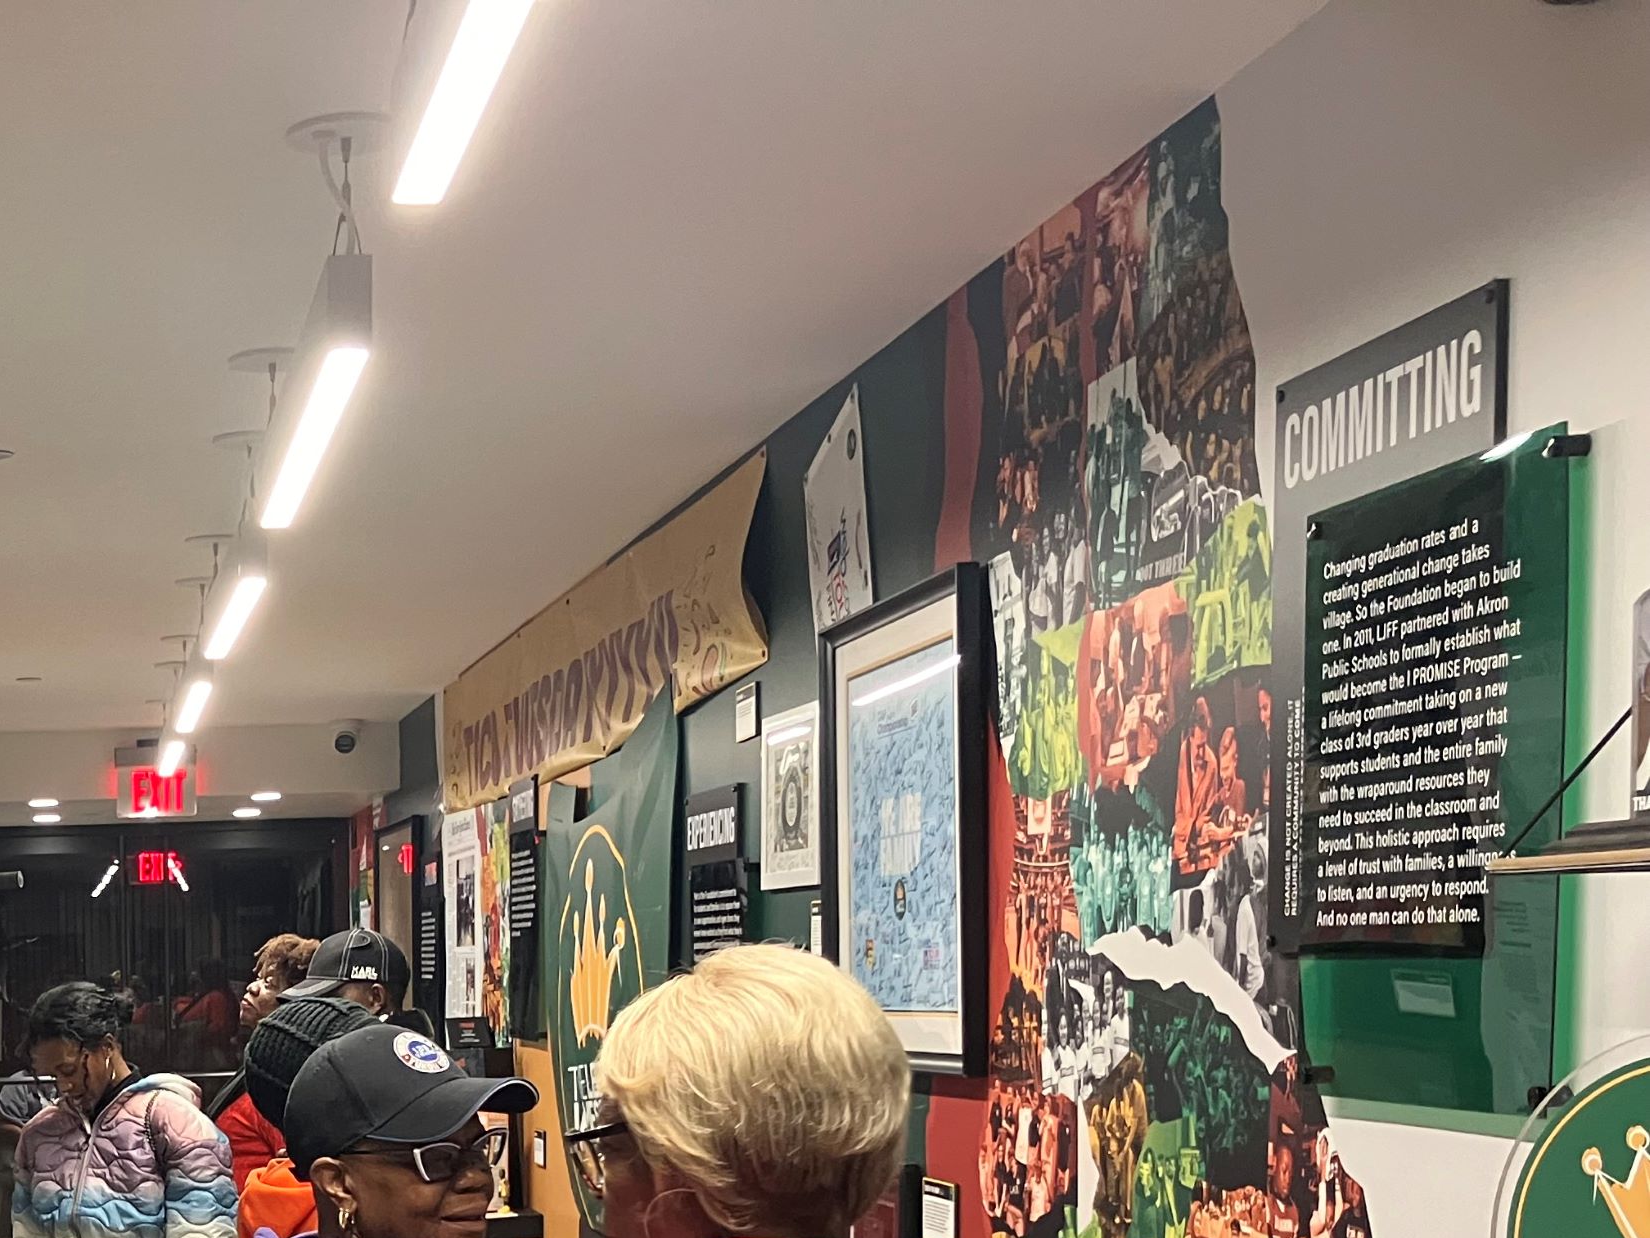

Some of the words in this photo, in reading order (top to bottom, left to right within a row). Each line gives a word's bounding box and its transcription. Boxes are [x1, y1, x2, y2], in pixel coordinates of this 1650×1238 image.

[1283, 328, 1484, 490] COMMITTING
[1323, 554, 1367, 580] Changing
[1367, 537, 1419, 571] graduation
[1421, 529, 1446, 550] rates
[1449, 517, 1468, 541] and
[1471, 519, 1479, 534] a
[1323, 582, 1360, 605] creating
[1361, 560, 1420, 599] generational
[1421, 553, 1459, 576] change
[1461, 543, 1490, 565] takes
[1322, 610, 1354, 630] village.
[1355, 603, 1368, 621] So
[1369, 599, 1386, 617] the
[1387, 584, 1442, 613] Foundation
[1444, 575, 1477, 598] began
[1479, 570, 1490, 588] to
[1493, 558, 1521, 584] build
[1322, 639, 1341, 655] one.
[1343, 633, 1352, 650] In
[1353, 627, 1375, 648] 2011,
[1376, 619, 1399, 642] LJFF
[1400, 606, 1449, 639] partnered
[1451, 600, 1474, 623] with
[1476, 595, 1509, 617] Akron
[131, 770, 186, 814] EXIT
[686, 806, 736, 851] EXPERIENCING
